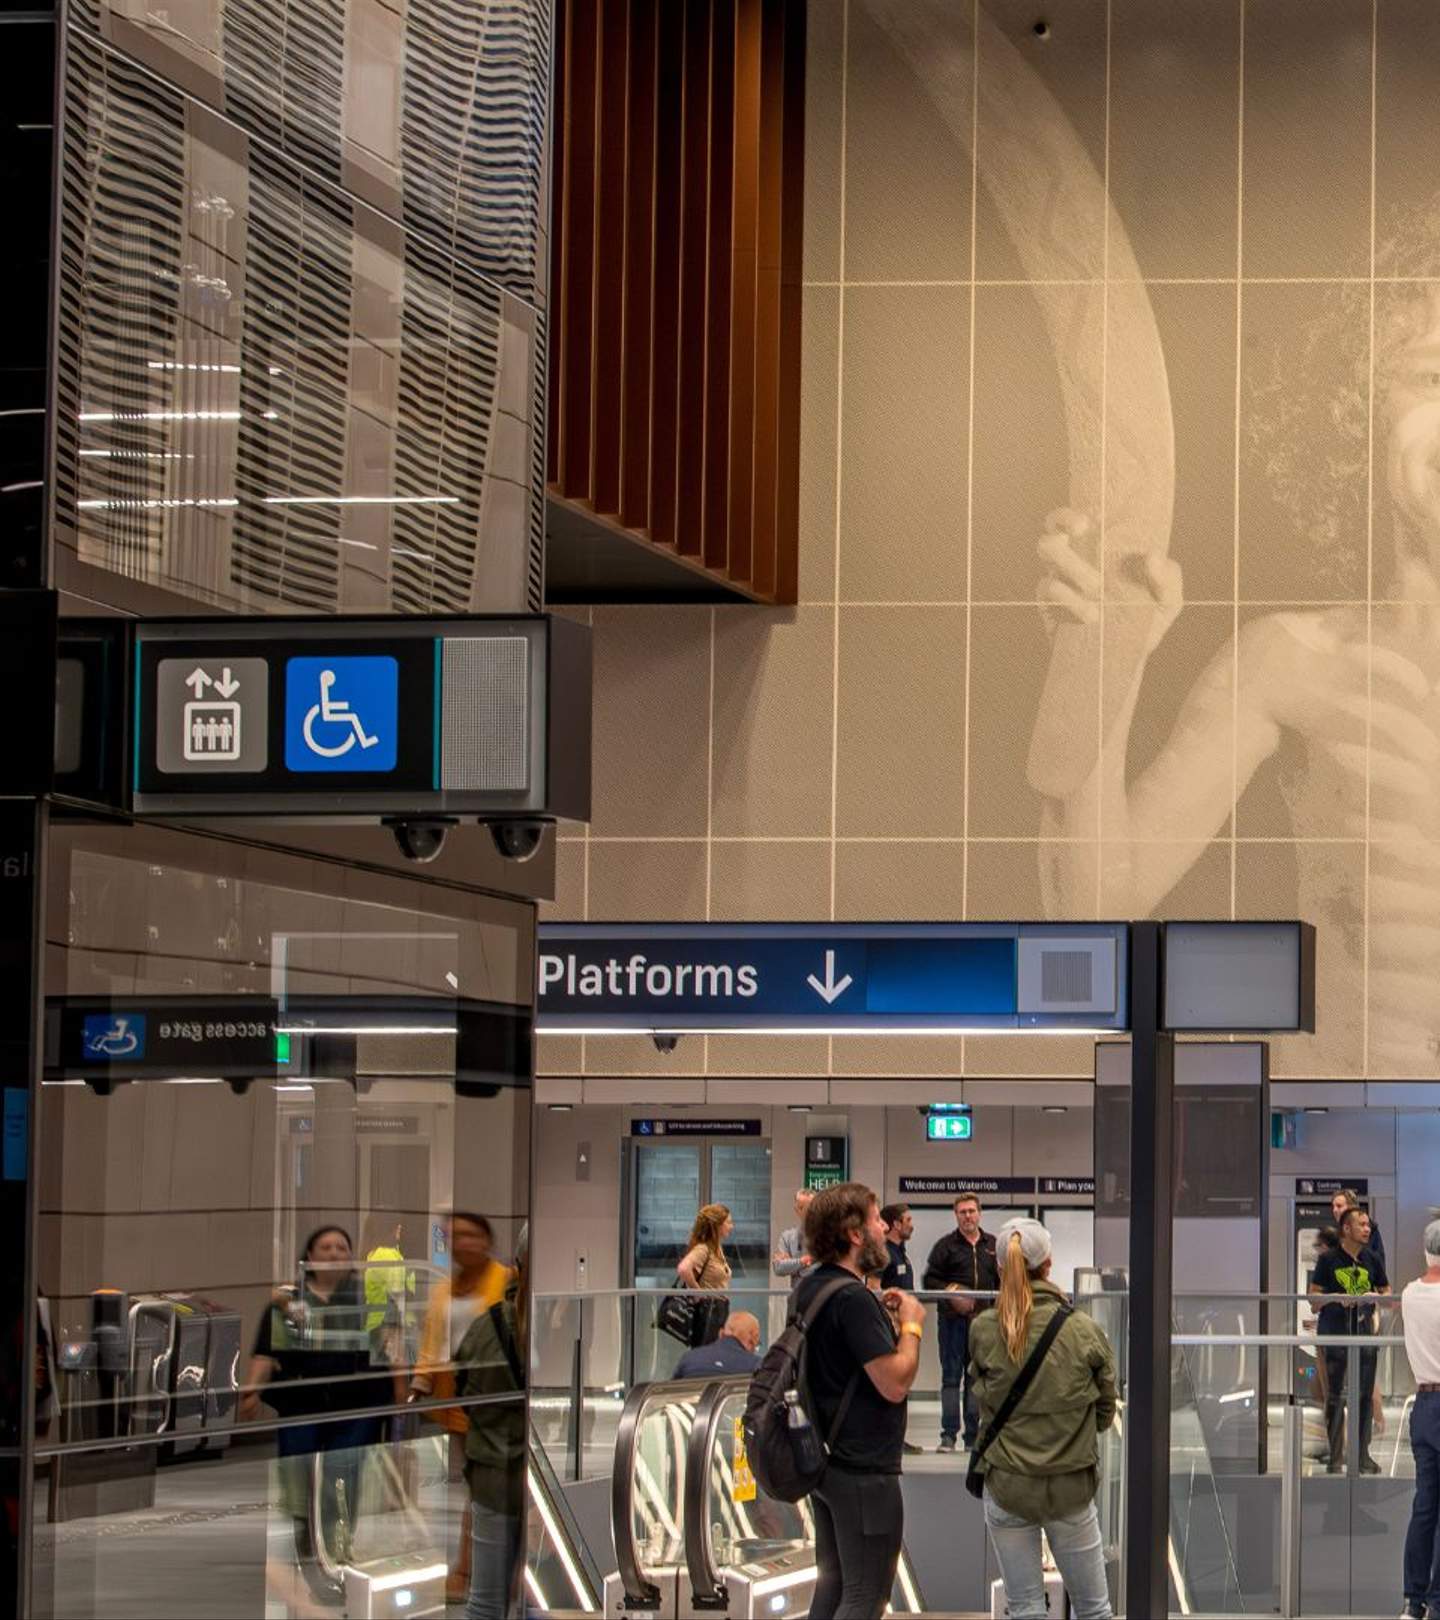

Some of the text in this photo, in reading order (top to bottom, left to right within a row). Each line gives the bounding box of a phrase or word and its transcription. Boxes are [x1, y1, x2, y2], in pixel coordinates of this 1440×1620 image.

[538, 954, 758, 996] Platforms
[905, 1180, 998, 1190] Welcome to Waterloo
[1058, 1181, 1077, 1191] Plan
